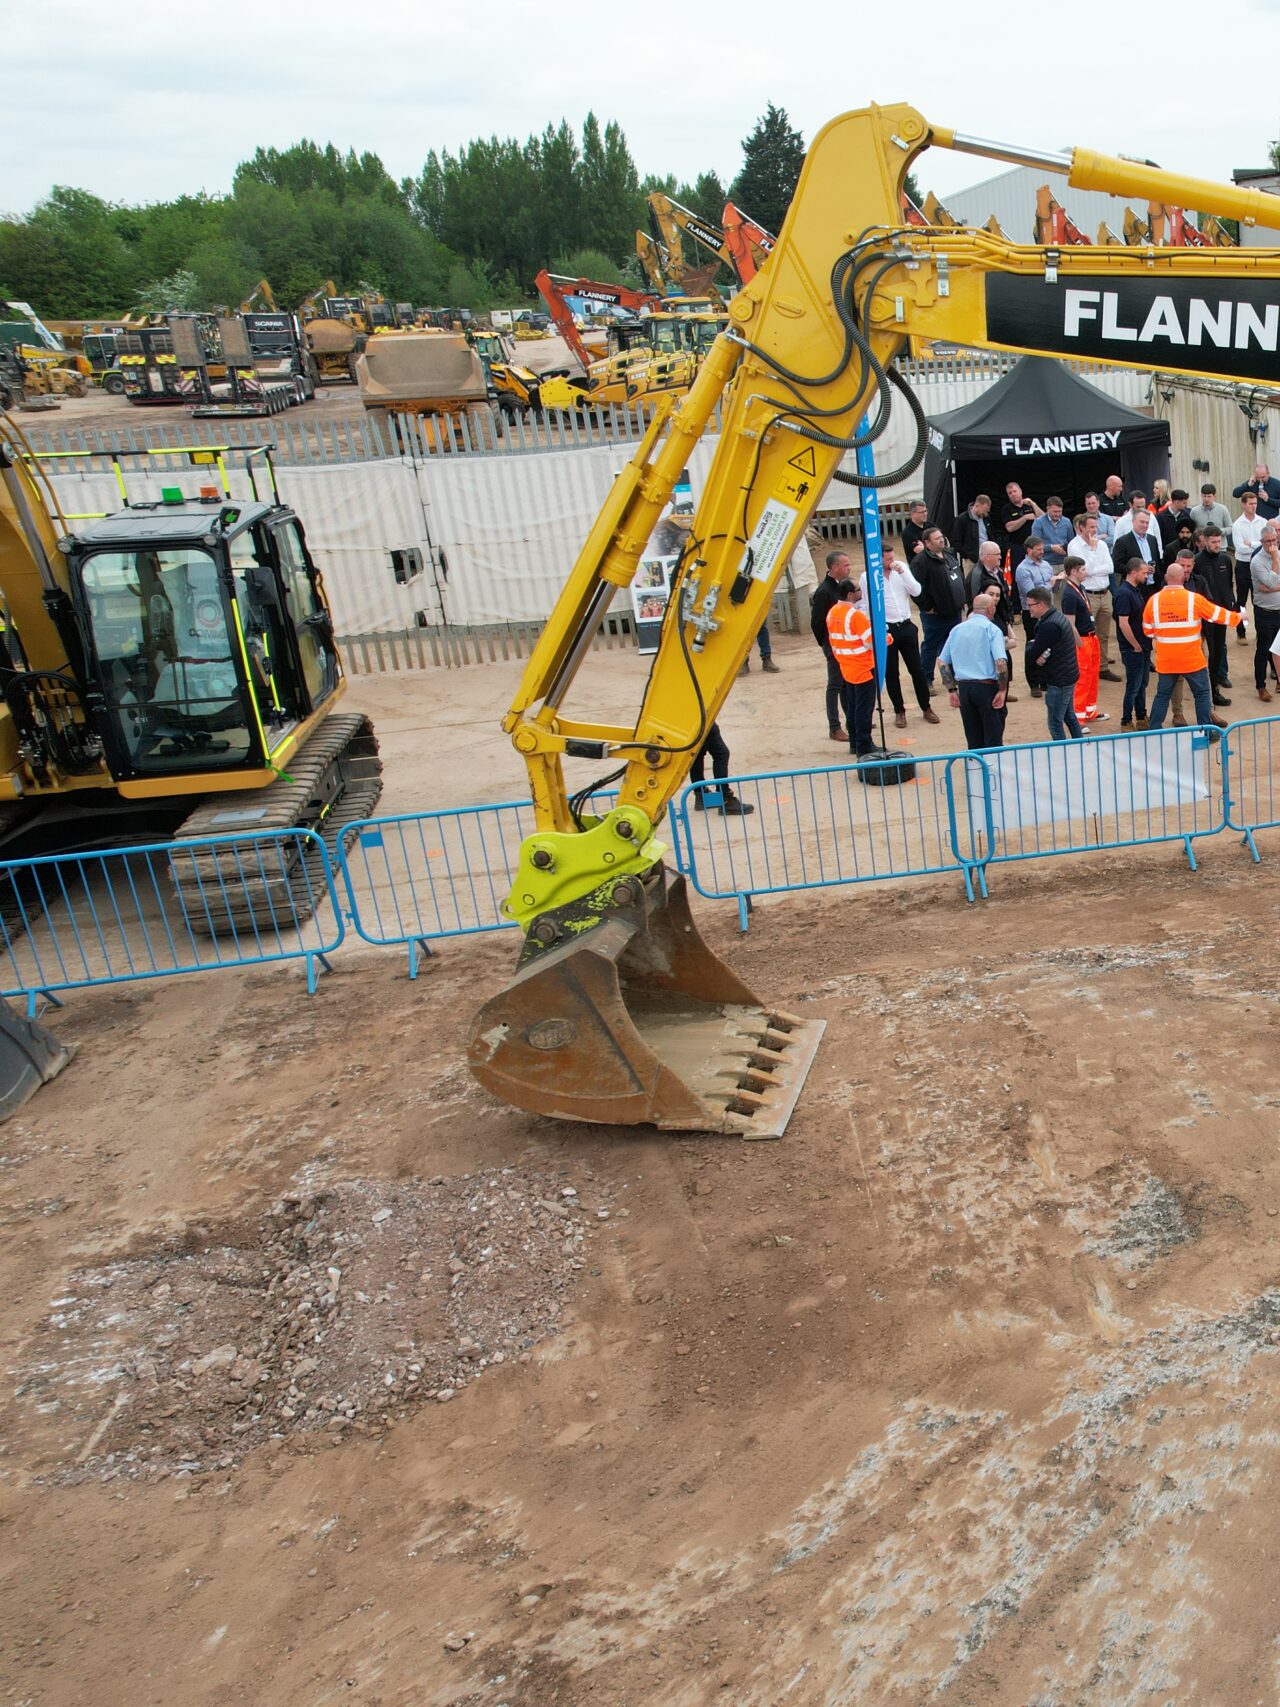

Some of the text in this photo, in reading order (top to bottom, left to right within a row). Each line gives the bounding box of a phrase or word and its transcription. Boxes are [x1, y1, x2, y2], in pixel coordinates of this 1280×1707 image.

[687, 222, 723, 249] FLANNERY
[578, 290, 616, 302] FLANNERY
[1001, 430, 1122, 456] FLANNERY
[767, 513, 781, 536] MILLER
